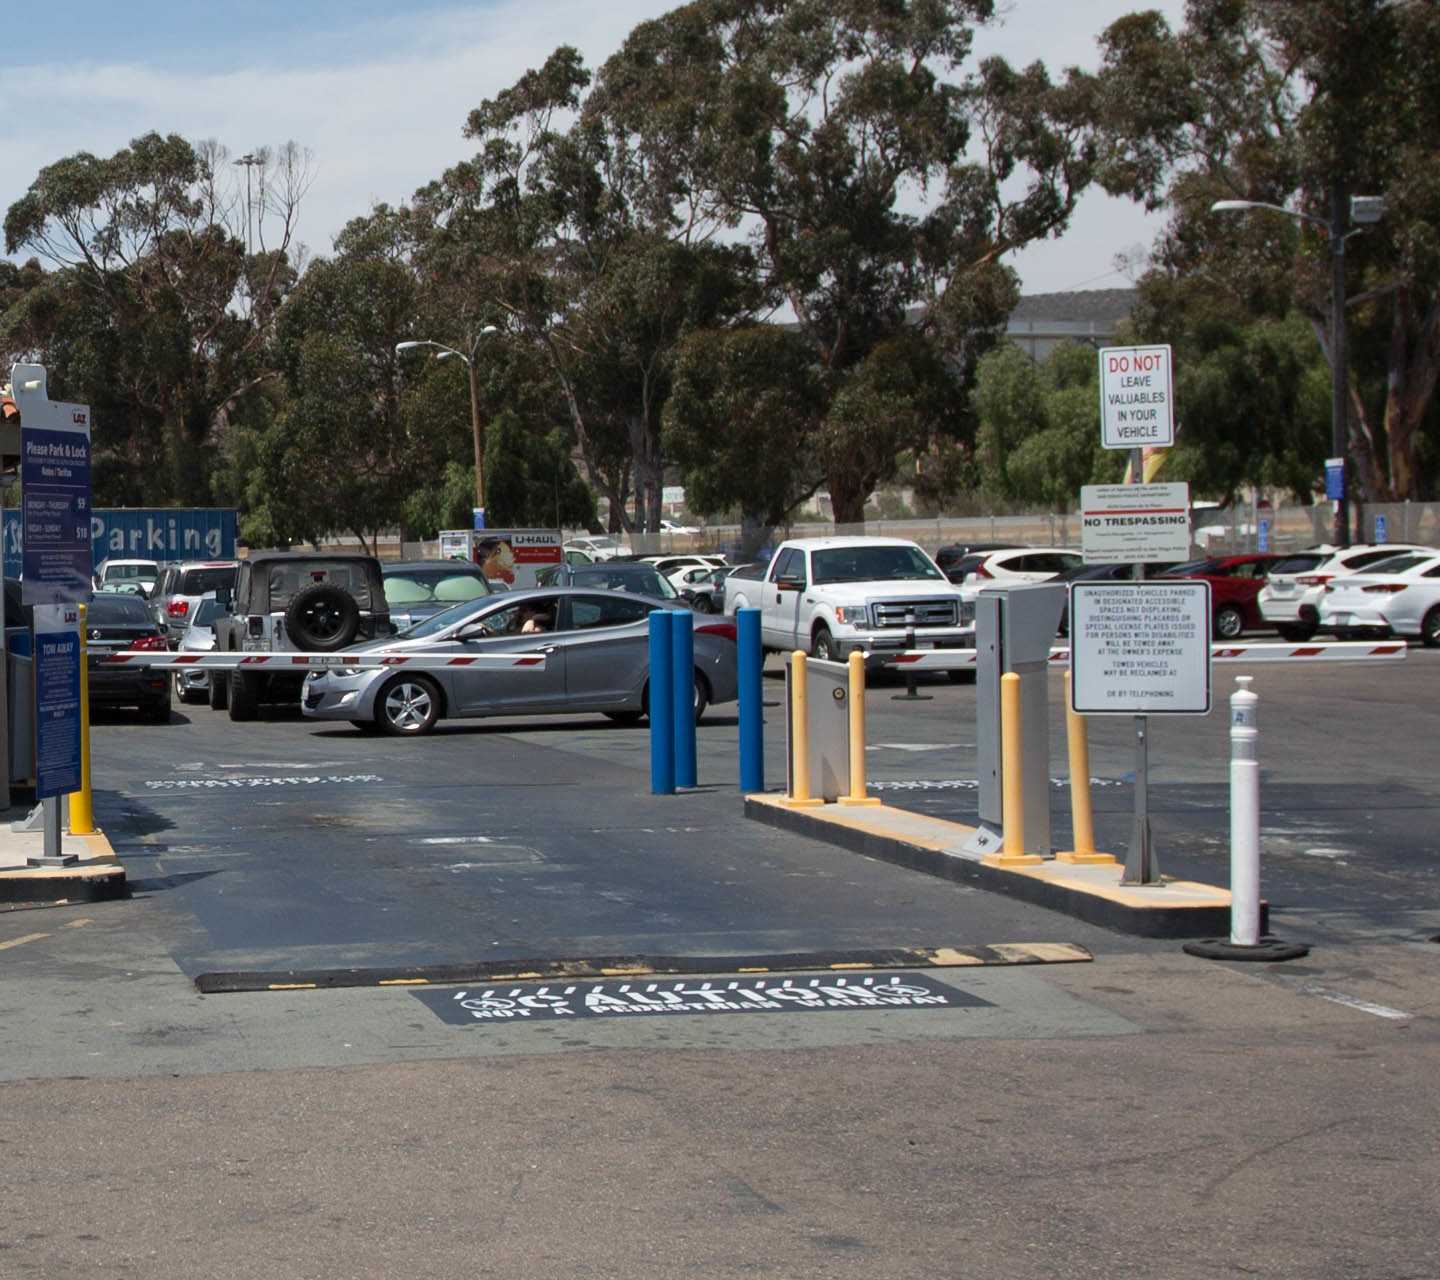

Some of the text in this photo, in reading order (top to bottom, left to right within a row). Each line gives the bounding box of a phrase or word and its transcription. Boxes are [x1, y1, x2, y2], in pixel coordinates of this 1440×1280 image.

[1109, 355, 1162, 373] DO NOT
[1121, 376, 1151, 388] LEAVE
[1108, 392, 1166, 405] VALUABLES
[1118, 409, 1157, 421] IN YOUR
[1117, 425, 1158, 438] VEHICLE
[1084, 516, 1186, 527] NO TRESPASSING
[90, 517, 222, 558] Parking
[515, 536, 556, 544] U-HAUL
[517, 985, 878, 1009] CAUTION
[471, 995, 949, 1019] NOT A PEDESTRIAN WALKWAY
